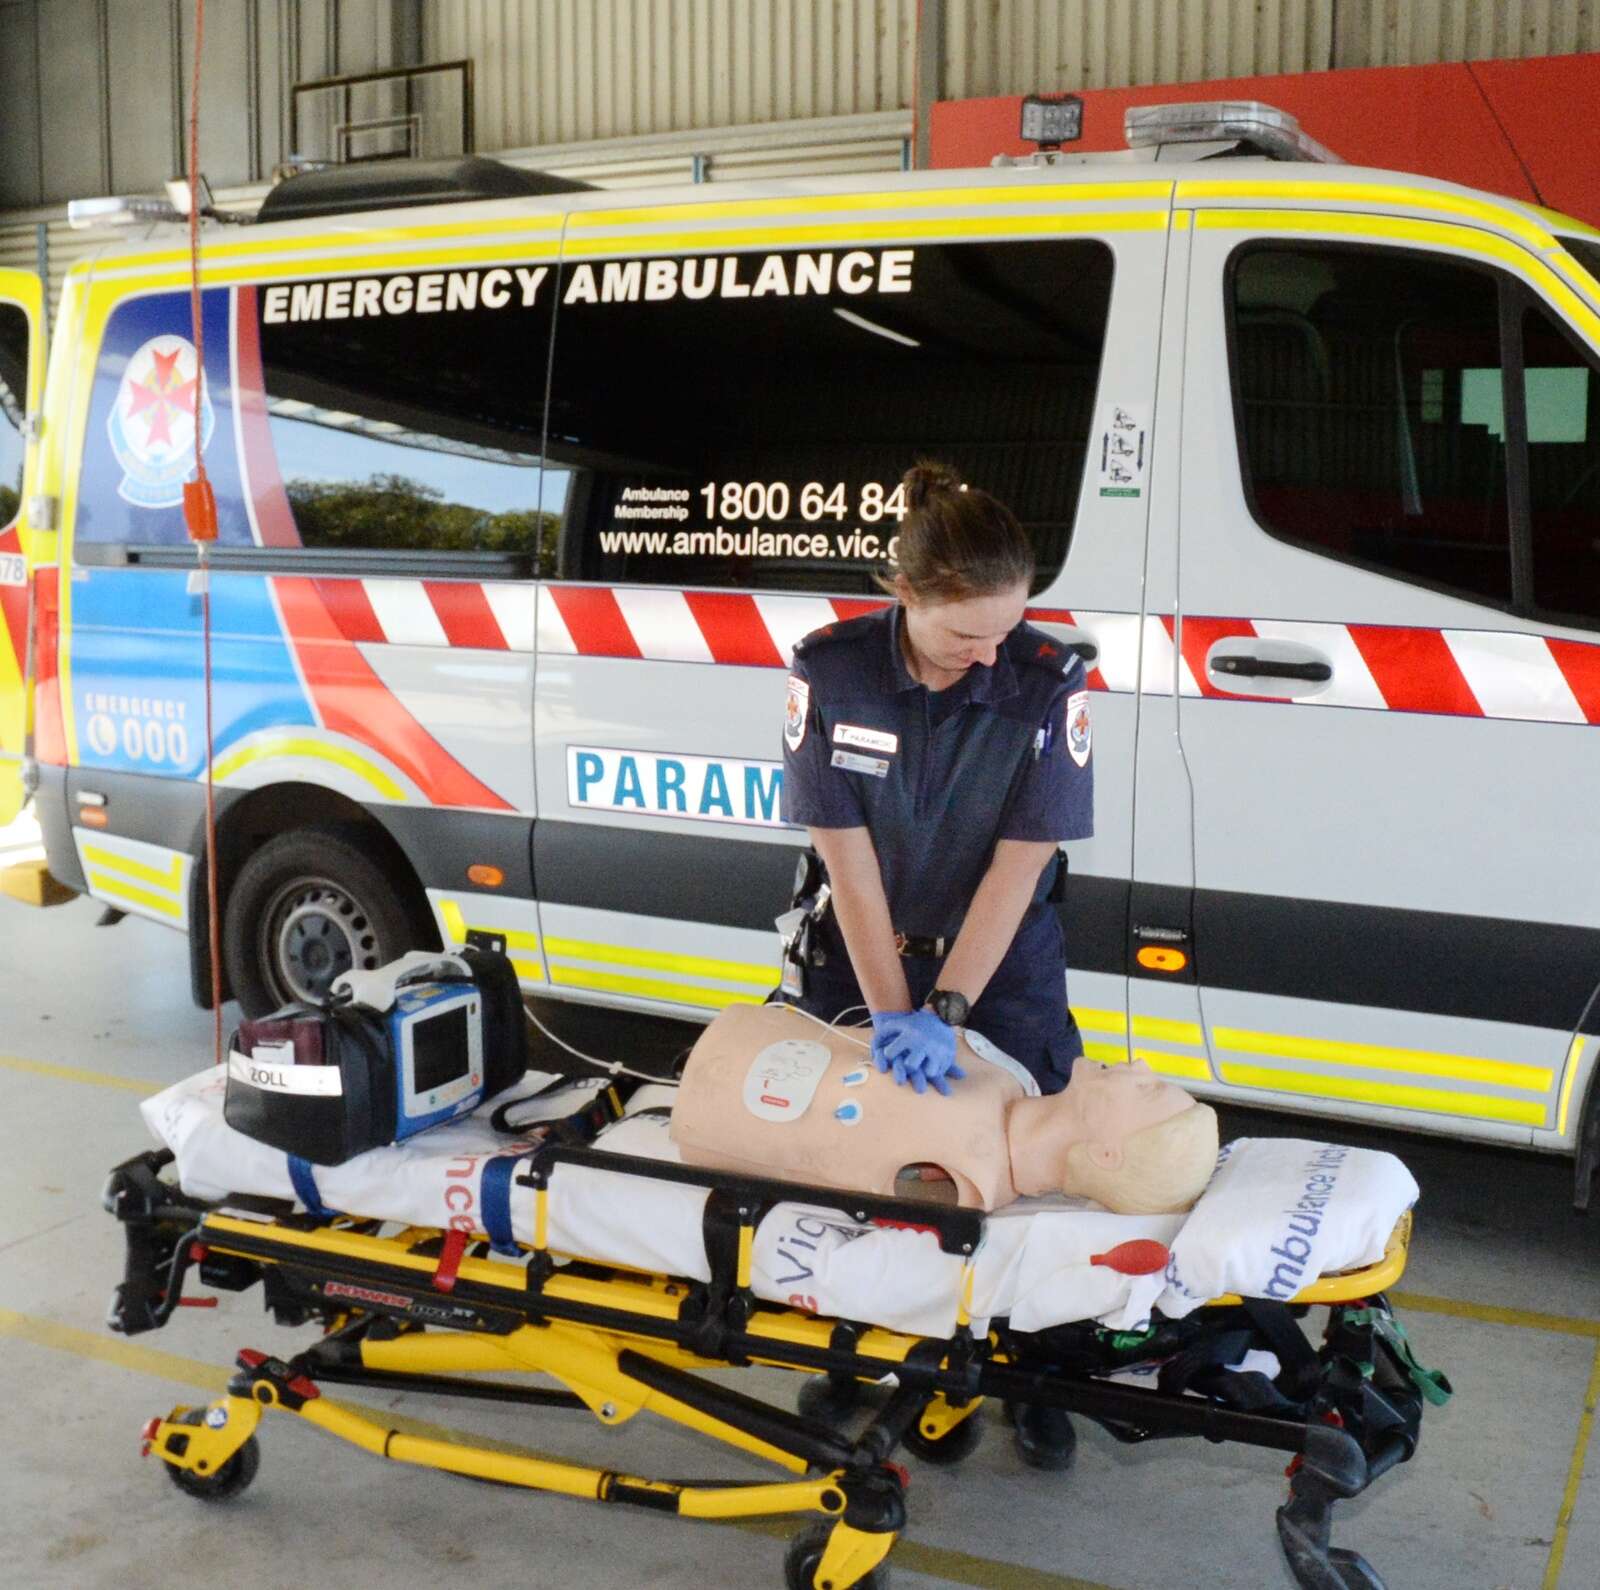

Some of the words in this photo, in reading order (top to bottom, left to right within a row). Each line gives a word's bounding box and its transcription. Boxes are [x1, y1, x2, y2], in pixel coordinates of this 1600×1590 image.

[264, 266, 549, 324] EMERGENCY
[563, 250, 914, 305] AMBULANCE
[622, 487, 690, 502] Ambulance
[700, 481, 790, 522] 1800
[800, 482, 848, 522] 64
[859, 482, 909, 522] 84
[614, 504, 690, 522] Membership
[86, 693, 186, 720] EMERGENCY
[575, 751, 790, 823] PARAM
[250, 1066, 288, 1087] ZOLL
